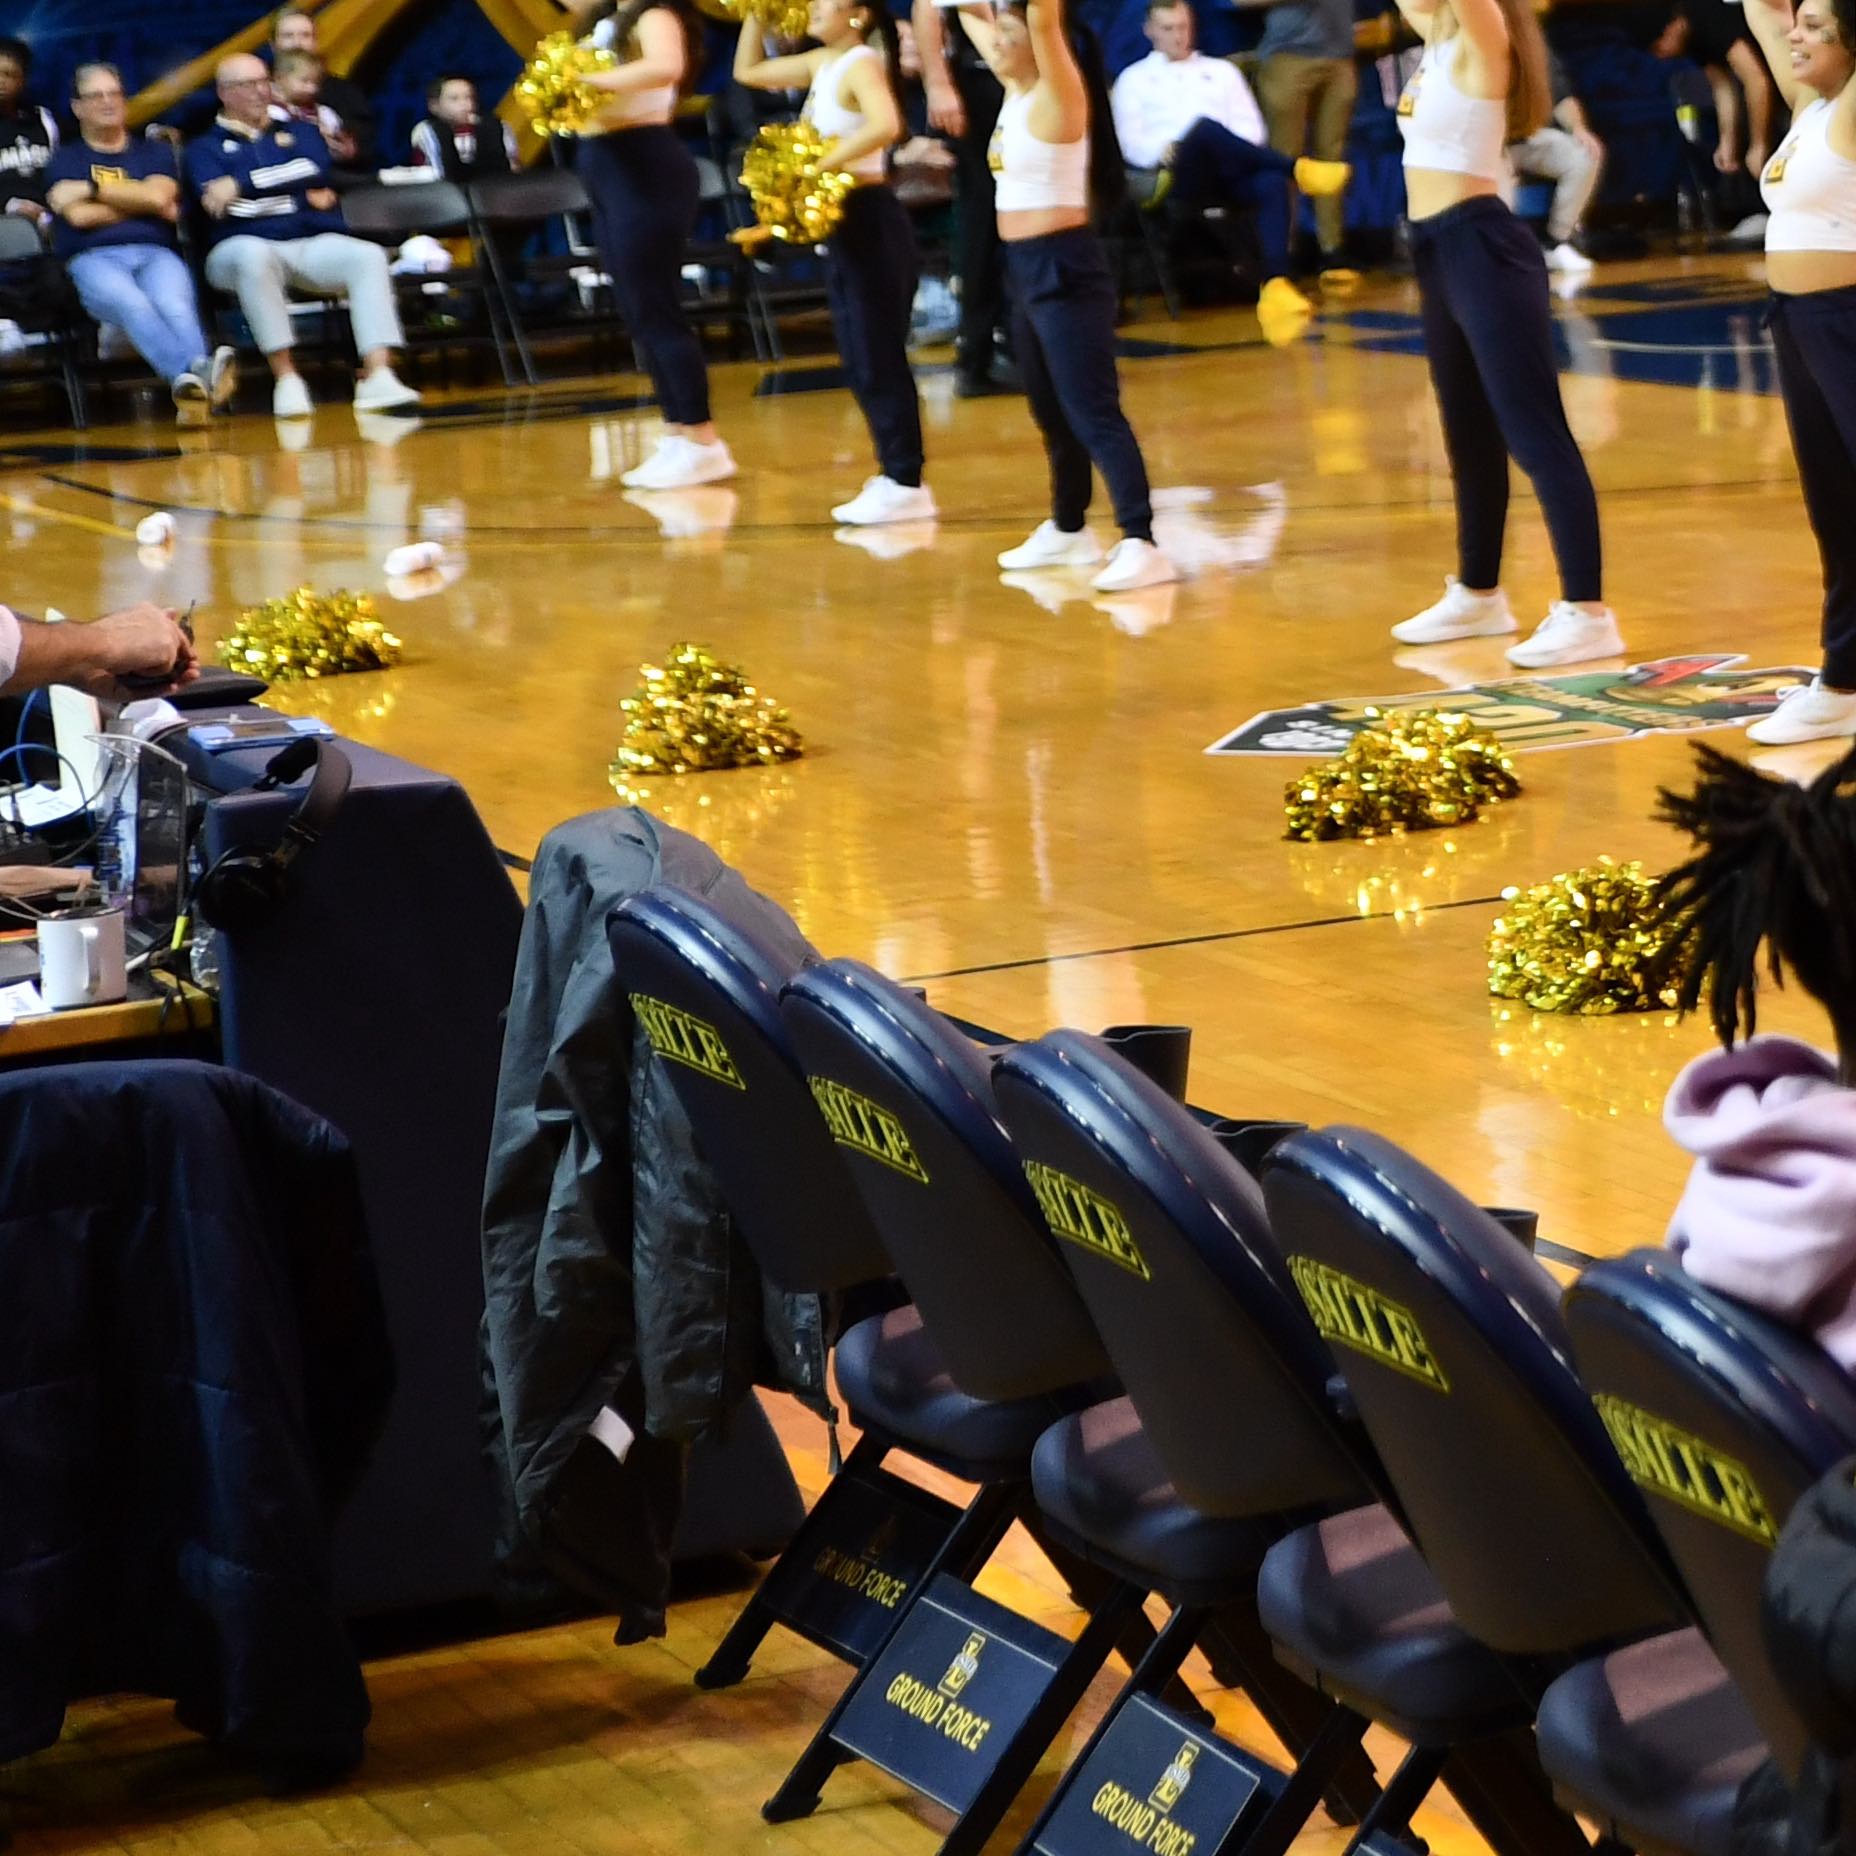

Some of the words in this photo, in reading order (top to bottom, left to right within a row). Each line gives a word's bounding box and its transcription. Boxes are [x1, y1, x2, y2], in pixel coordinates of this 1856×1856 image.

[858, 1567, 908, 1609] FORCE
[885, 1671, 944, 1732] GROUND
[934, 1701, 993, 1753] FORCE
[1092, 1780, 1156, 1841] GROUND
